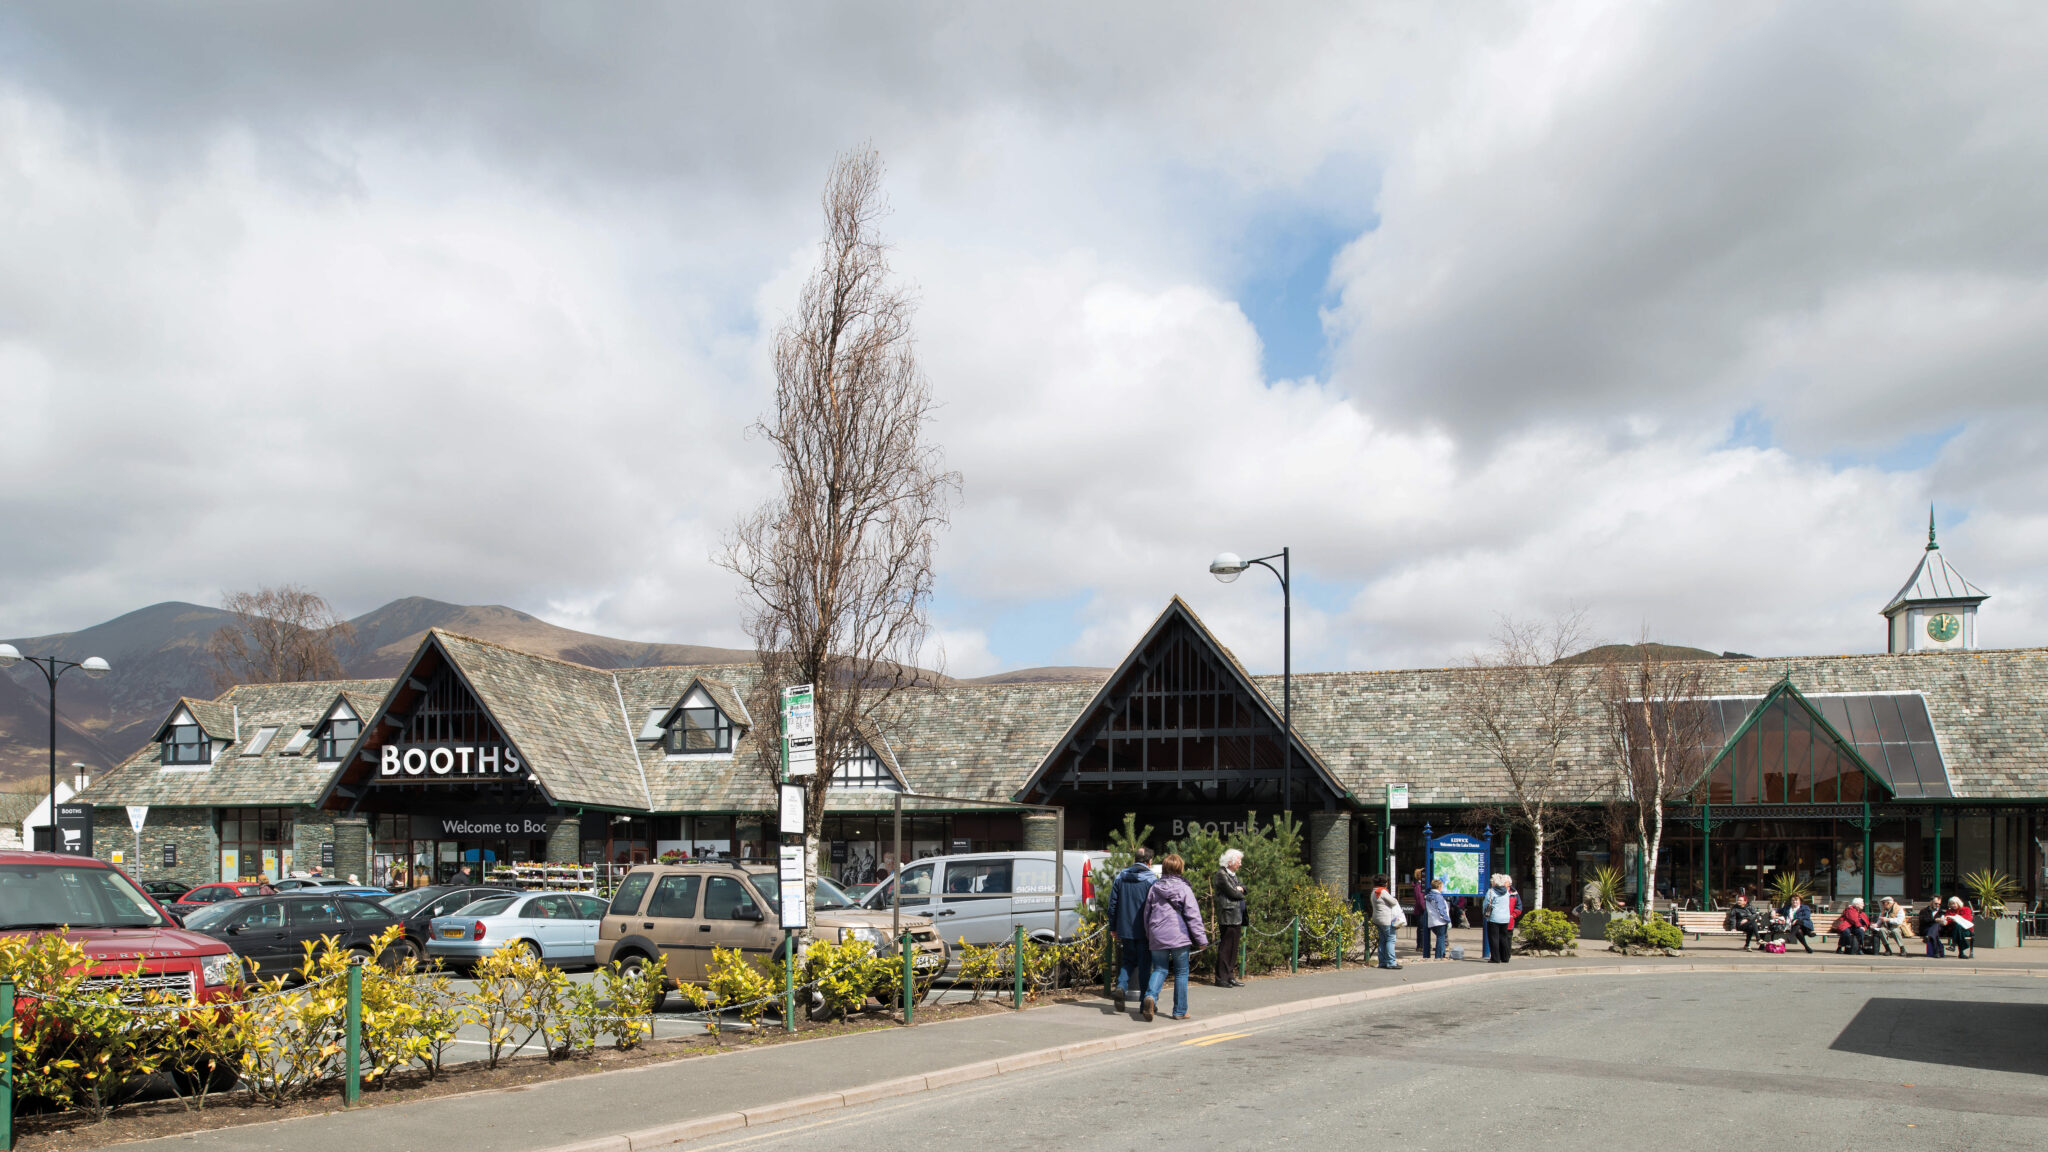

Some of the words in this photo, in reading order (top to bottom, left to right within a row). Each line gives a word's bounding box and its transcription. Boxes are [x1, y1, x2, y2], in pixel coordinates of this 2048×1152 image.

[381, 744, 520, 775] BOOTHS
[442, 820, 501, 834] Welcome
[505, 821, 519, 833] to
[524, 819, 547, 833] Boo
[1016, 885, 1037, 893] SIGN
[1038, 884, 1056, 892] SHO
[119, 950, 182, 958] ROVER
